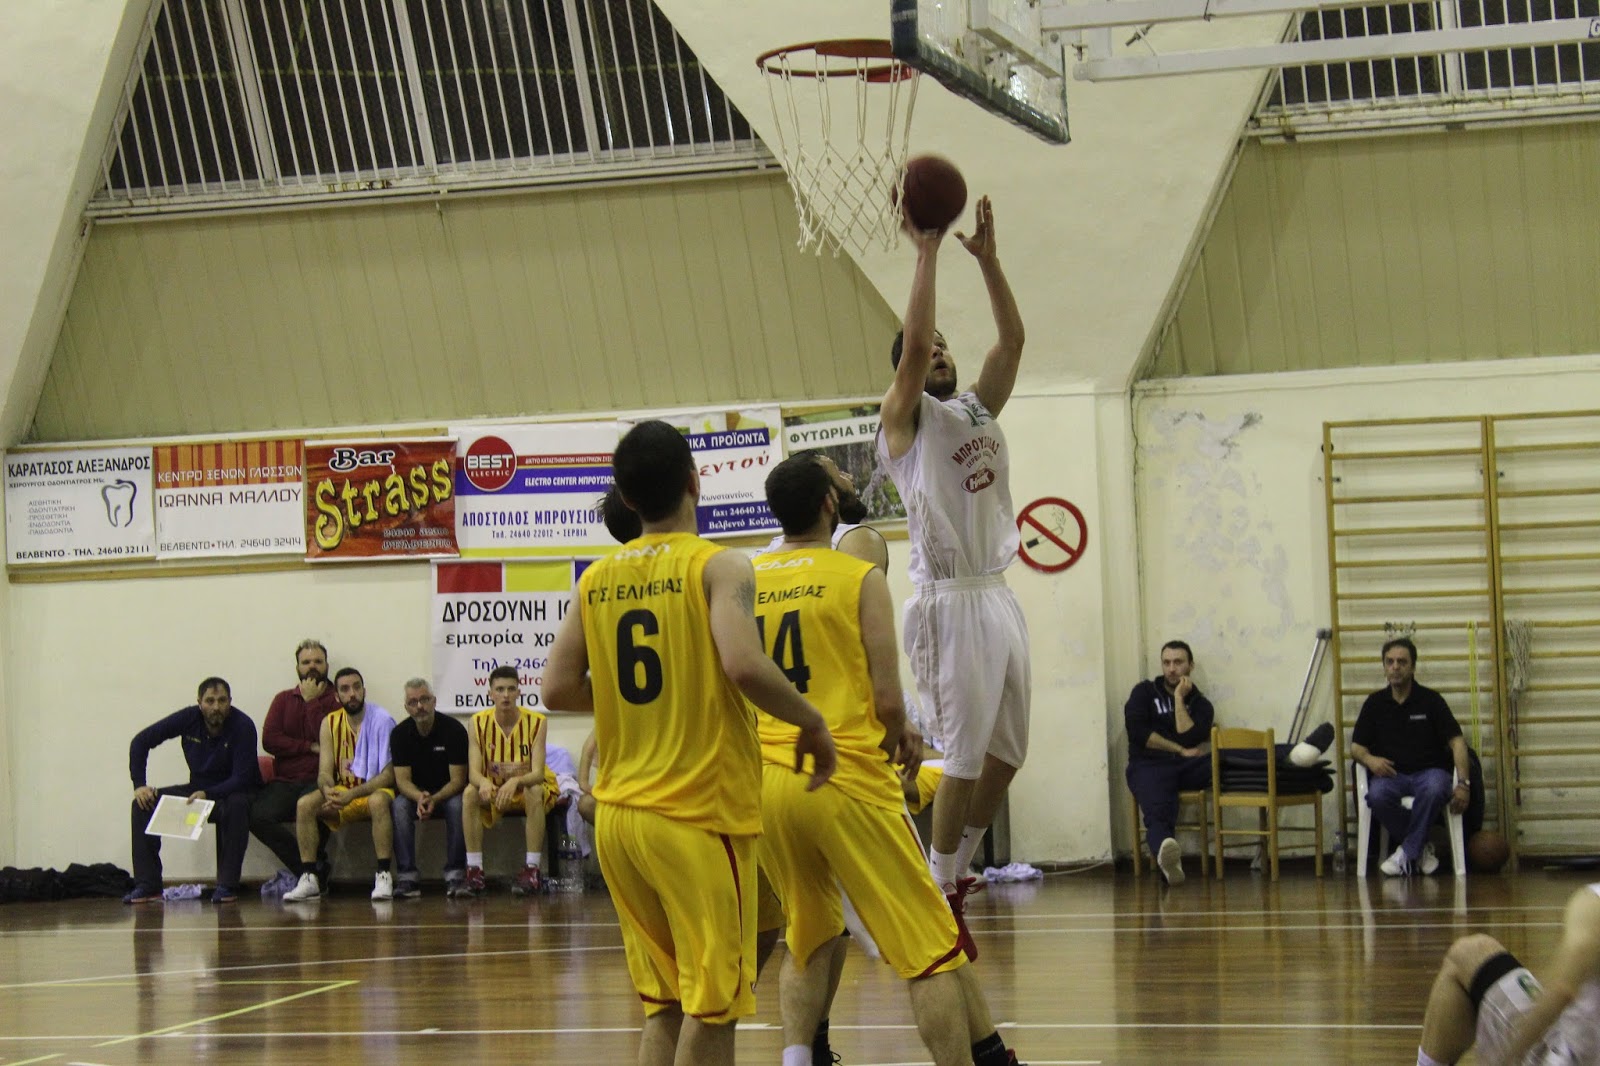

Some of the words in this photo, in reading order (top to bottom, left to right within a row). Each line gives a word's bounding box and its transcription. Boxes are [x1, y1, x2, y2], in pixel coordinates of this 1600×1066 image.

[688, 437, 707, 449] ΙΚΑ
[711, 431, 766, 447] ΠΡΟΪΟΝΤΑ
[789, 426, 854, 443] ΦΥΤΩΡΙΑ
[8, 460, 73, 477] ΚΑΡΑΤΑΣΟΣ
[76, 456, 150, 473] ΑΛΕΞΑΝΔΡΟΣ
[329, 448, 395, 471] Bar
[467, 454, 513, 469] BEST
[158, 469, 203, 482] ΚΕΝΤΡΟ
[206, 467, 246, 480] ΞΕΝΩΝ
[249, 465, 302, 478] ΓΛΩΣΣΩΝ
[471, 470, 510, 478] ELECTRIC
[525, 477, 552, 487] ELECTRO
[553, 476, 577, 486] CENTER
[159, 492, 223, 508] ΙΩΑΝΝΑ
[229, 488, 302, 504] ΜΑΛΛΟΥ
[315, 458, 452, 550] Strass
[701, 490, 754, 502] Κωνσταντίνος
[462, 511, 529, 527] ΑΠΟΣΤΟΛΟΣ
[730, 507, 755, 516] 24640
[510, 530, 531, 538] 24640
[534, 529, 554, 538] 22012
[709, 520, 746, 530] Βελβεντό
[240, 538, 271, 548] 24640
[274, 537, 301, 546] 32414
[16, 549, 65, 559] ΒΕΛΒΕΝΤΟ
[73, 547, 94, 557] ΤΗΛ.
[97, 546, 123, 555] 24640
[125, 545, 150, 554] 32111
[616, 577, 683, 601] ΕΛΙΜΕΙΑΣ
[758, 585, 826, 604] ΕΛΙΜΕΙΑΣ
[443, 600, 546, 622] ΔΡΟΣΟΥΝΗ
[445, 629, 524, 648] εμπορία
[616, 608, 663, 705] 6
